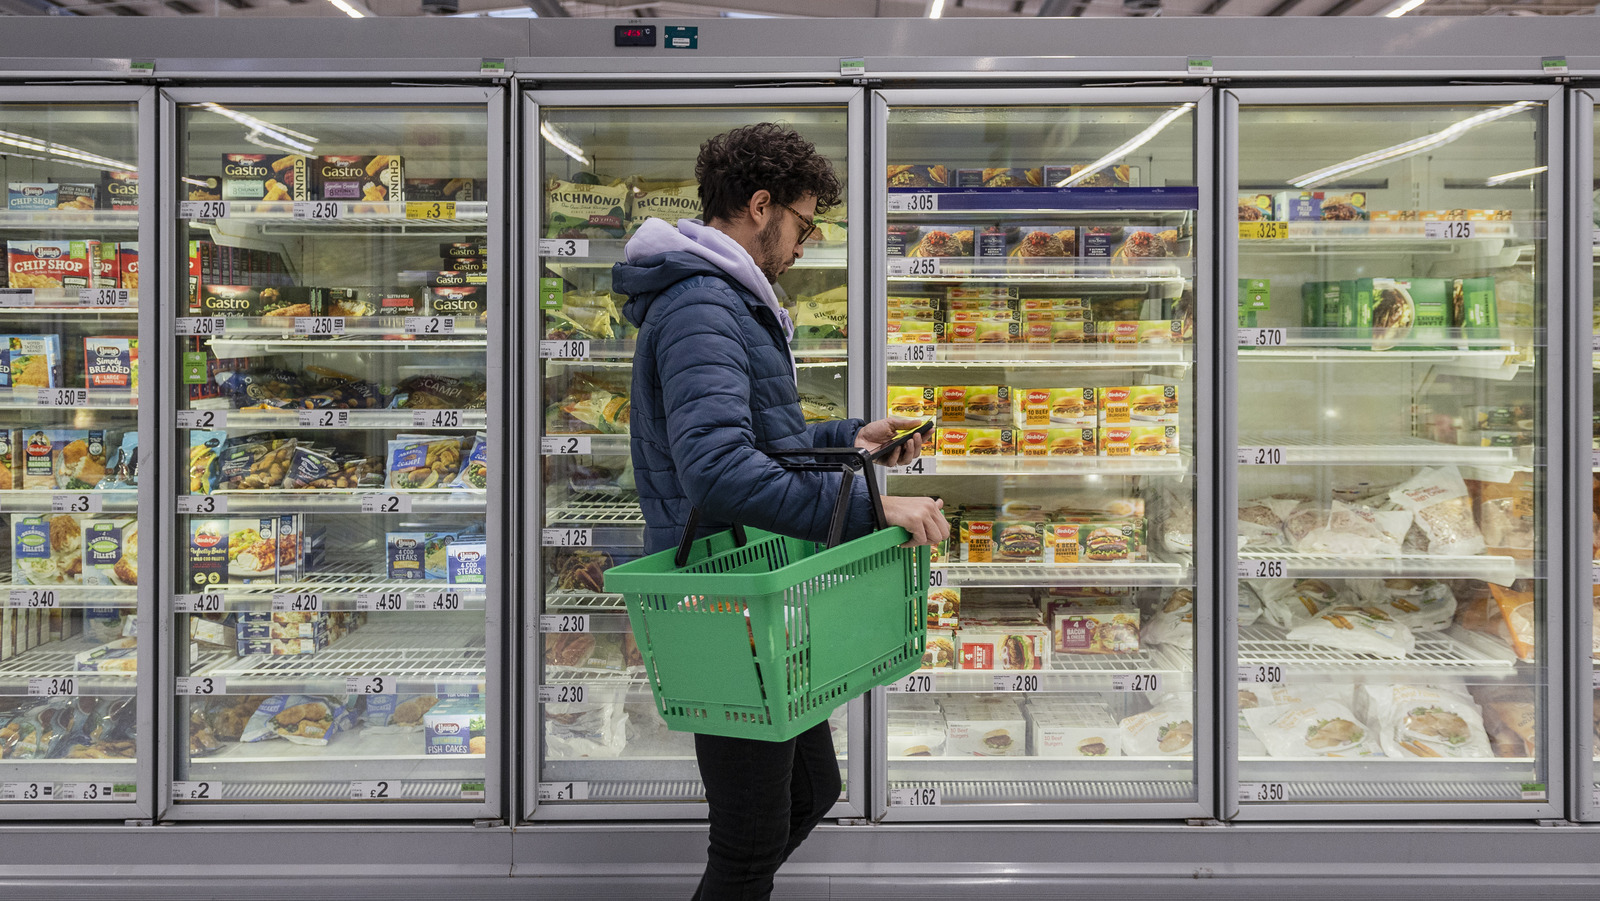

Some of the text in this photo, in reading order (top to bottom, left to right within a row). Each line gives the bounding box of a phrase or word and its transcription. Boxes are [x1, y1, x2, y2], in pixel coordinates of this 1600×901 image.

[225, 164, 267, 176] Gastro
[322, 166, 363, 177] Gastro
[296, 160, 304, 199] CHUNK
[390, 160, 398, 198] CHUNK
[108, 184, 138, 195] Gast
[11, 197, 55, 206] CHIP SHOP
[551, 192, 620, 206] RICHMOND
[427, 203, 441, 218] £3
[558, 240, 576, 256] £3
[14, 259, 82, 272] CHIP SHOP
[436, 276, 463, 284] Gastro
[206, 297, 249, 309] Gastro
[433, 300, 478, 311] Gastro
[425, 318, 439, 333] £2
[89, 366, 130, 374] BREADED
[96, 358, 122, 367] Simply
[95, 376, 100, 384] 4
[196, 411, 214, 427] £2
[319, 411, 333, 427] £2
[560, 438, 579, 454] £2
[906, 458, 924, 474] £4
[71, 496, 89, 512] £3
[196, 497, 215, 512] £3
[381, 496, 399, 512] £2
[22, 544, 44, 553] FILLETS
[93, 550, 116, 559] FILLETS
[195, 678, 214, 694] £3
[365, 678, 383, 693] £3
[445, 745, 467, 753] CAKES
[24, 784, 38, 799] £3
[84, 784, 97, 799] £3
[191, 782, 209, 798] £2
[370, 782, 388, 798] £2
[557, 783, 573, 799] £1
